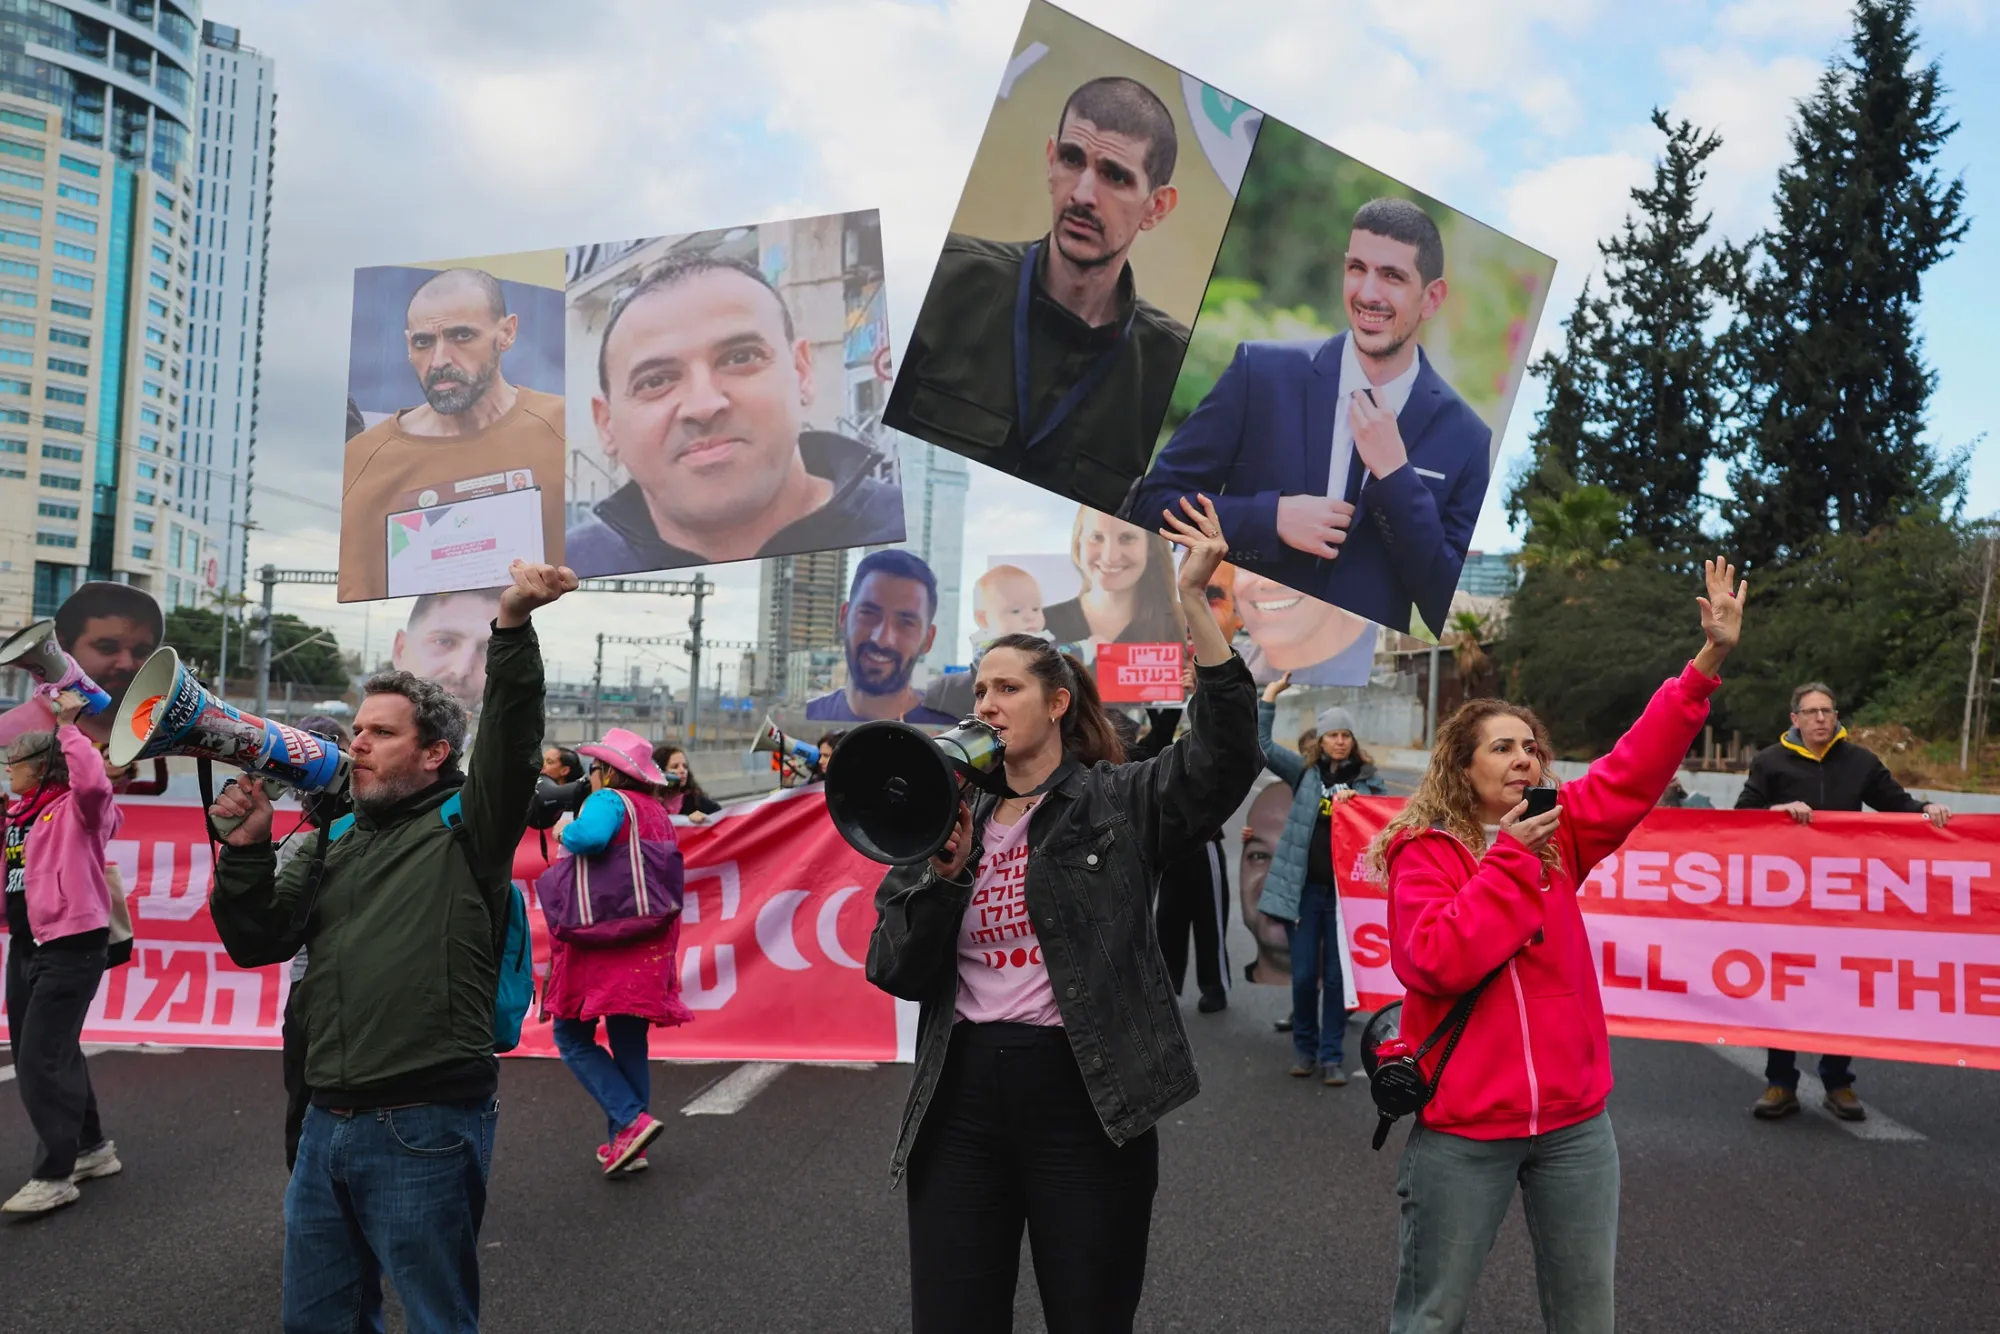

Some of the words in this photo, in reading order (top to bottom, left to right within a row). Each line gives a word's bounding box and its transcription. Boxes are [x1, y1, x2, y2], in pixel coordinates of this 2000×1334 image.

[1131, 647, 1177, 665] עדיין
[1120, 668, 1178, 682] בעזה.
[996, 864, 1027, 881] עד
[1577, 850, 1991, 916] RESIDENT
[1602, 941, 1688, 994] LL
[1711, 948, 1816, 1002] OF
[1841, 956, 2000, 1016] THE
